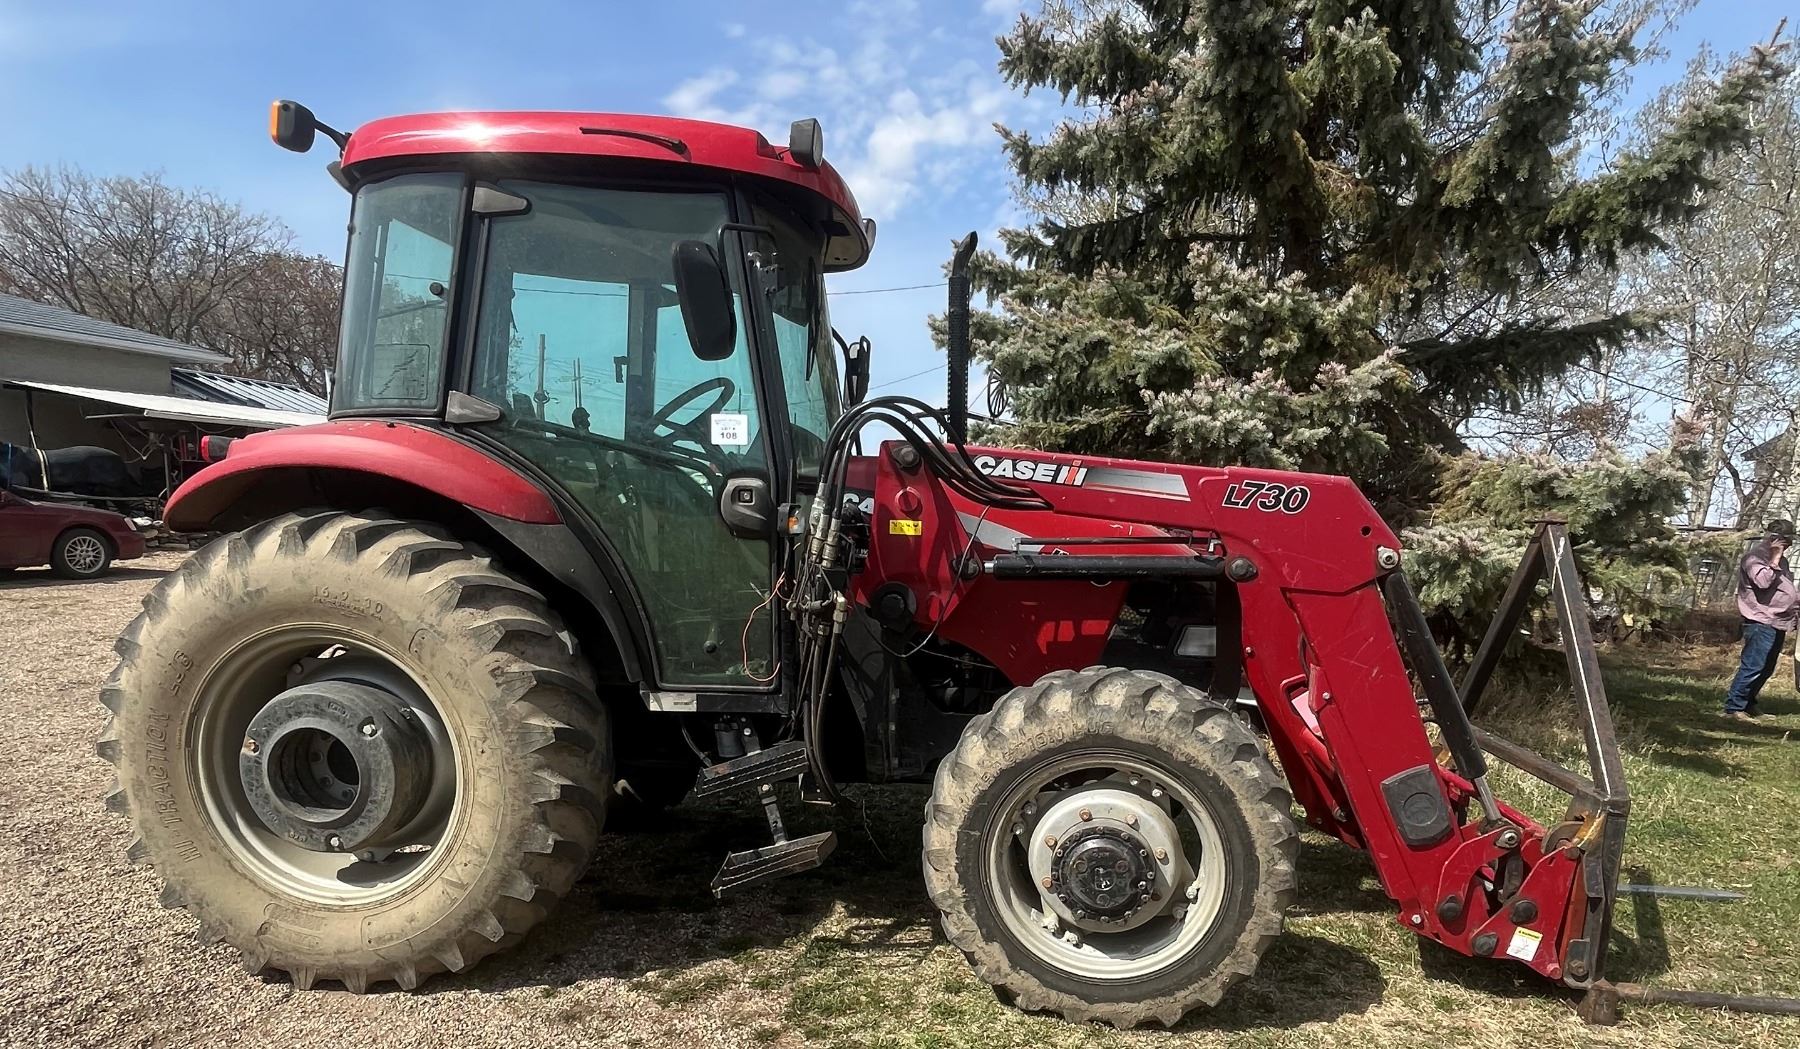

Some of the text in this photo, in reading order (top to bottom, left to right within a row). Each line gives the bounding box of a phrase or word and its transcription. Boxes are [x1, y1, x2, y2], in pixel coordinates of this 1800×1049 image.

[720, 432, 737, 440] 108
[974, 455, 1058, 483] CASE
[1222, 480, 1310, 514] L730
